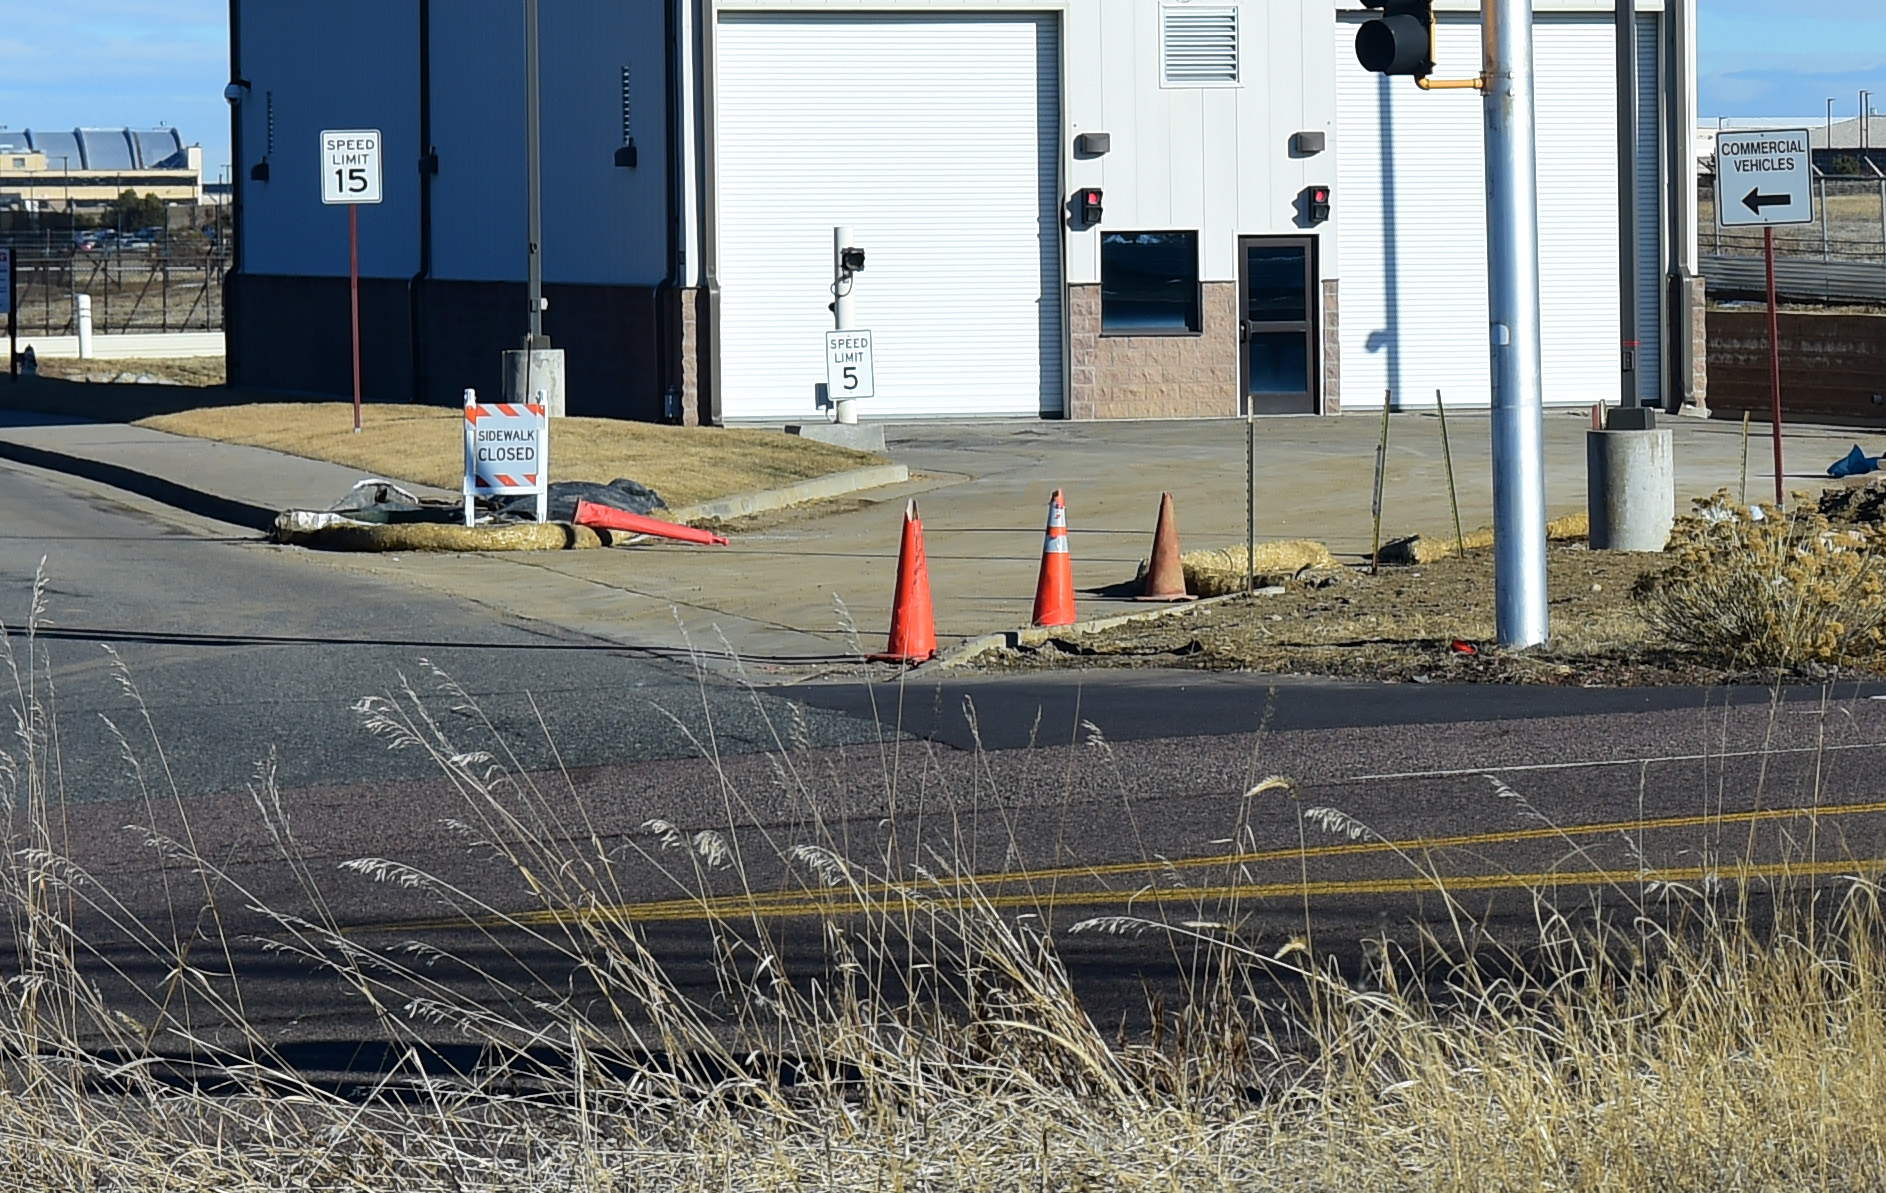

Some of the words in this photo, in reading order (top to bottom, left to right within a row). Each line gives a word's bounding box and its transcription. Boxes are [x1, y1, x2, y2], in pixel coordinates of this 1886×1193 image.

[327, 139, 375, 150] SPEED
[1721, 140, 1805, 155] COMMERCIAL
[332, 154, 369, 165] LIMIT
[1734, 158, 1795, 172] VEHICLES
[335, 168, 368, 193] 15
[830, 338, 868, 349] SPEED
[834, 351, 863, 363] LIMIT
[843, 366, 858, 390] 5
[478, 430, 535, 442] SIDEWALK
[478, 447, 535, 462] CLOSED
